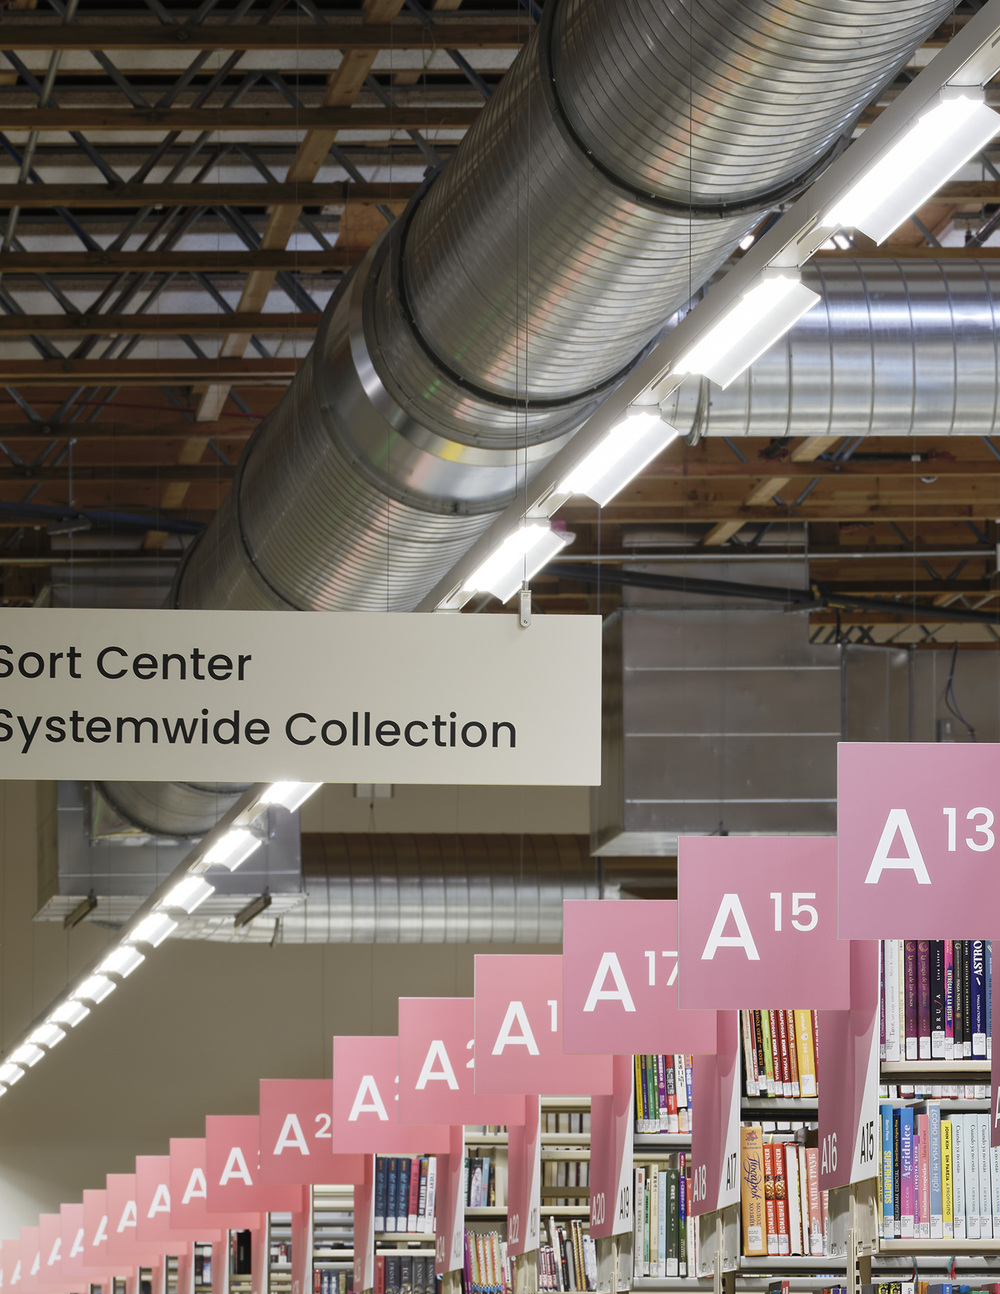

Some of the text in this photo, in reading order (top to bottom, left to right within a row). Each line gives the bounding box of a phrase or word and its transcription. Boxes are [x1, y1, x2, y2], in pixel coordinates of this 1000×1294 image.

[96, 645, 252, 681] Center
[285, 711, 517, 748] Collection
[547, 1000, 558, 1032] 1
[348, 1075, 389, 1121] A
[314, 1113, 333, 1138] 2
[859, 1120, 874, 1165] A15
[218, 1147, 253, 1186] A
[808, 1153, 817, 1179] ТРАУБ
[821, 1132, 837, 1175] A16
[902, 1124, 913, 1179] Agridulce
[692, 1164, 707, 1203] A18
[725, 1152, 737, 1192] A17
[591, 1192, 606, 1226] A20
[508, 1213, 519, 1246] A22
